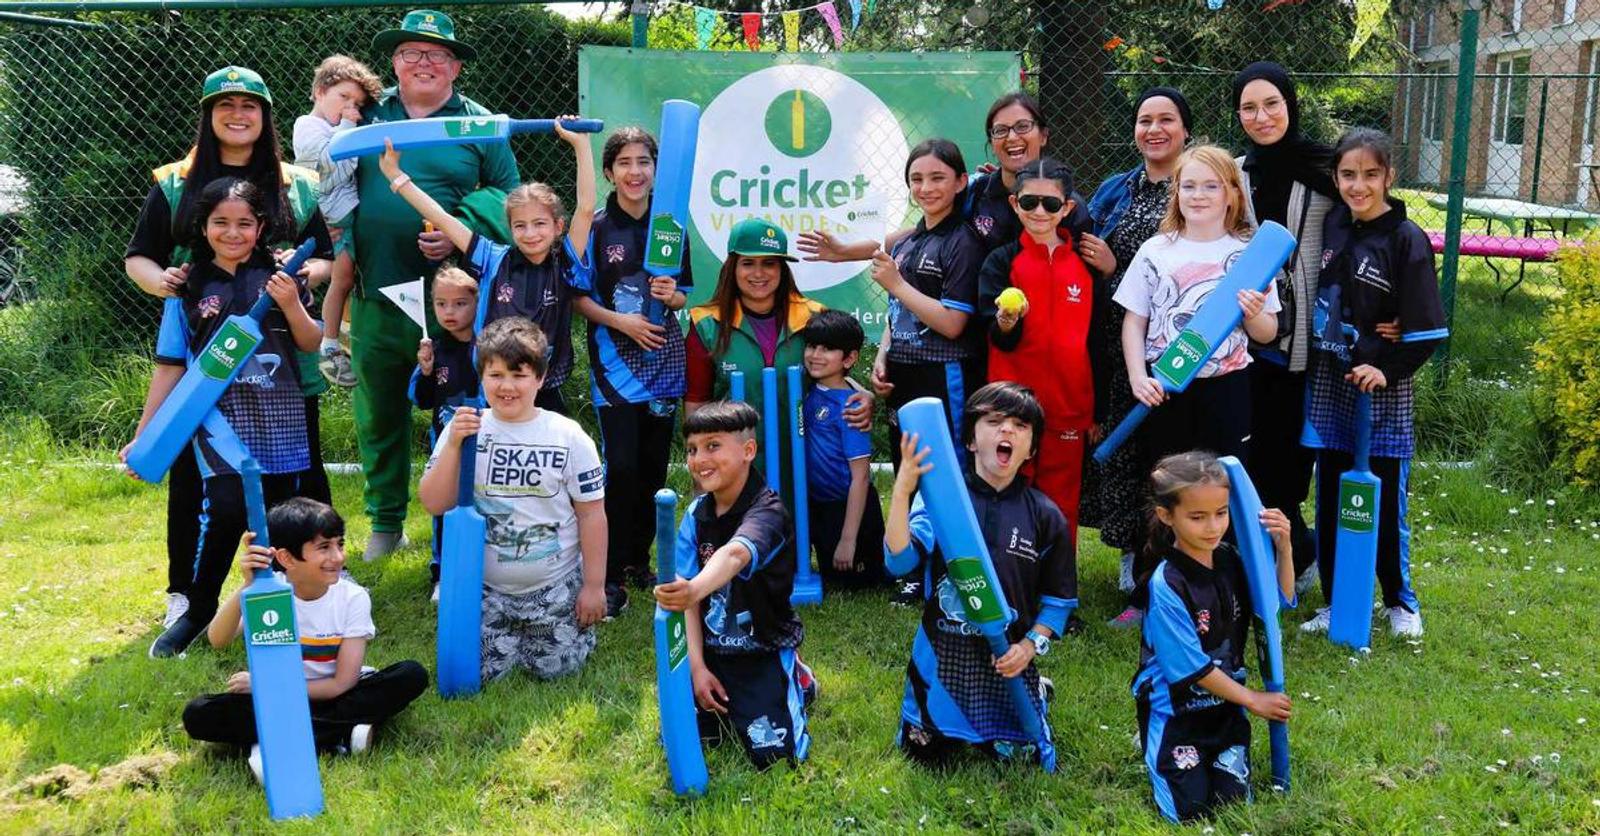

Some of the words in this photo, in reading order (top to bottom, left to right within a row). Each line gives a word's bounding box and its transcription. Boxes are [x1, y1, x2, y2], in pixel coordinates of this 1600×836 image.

[710, 165, 871, 209] Cricket
[492, 448, 566, 469] SKATE
[490, 467, 542, 487] EPIC
